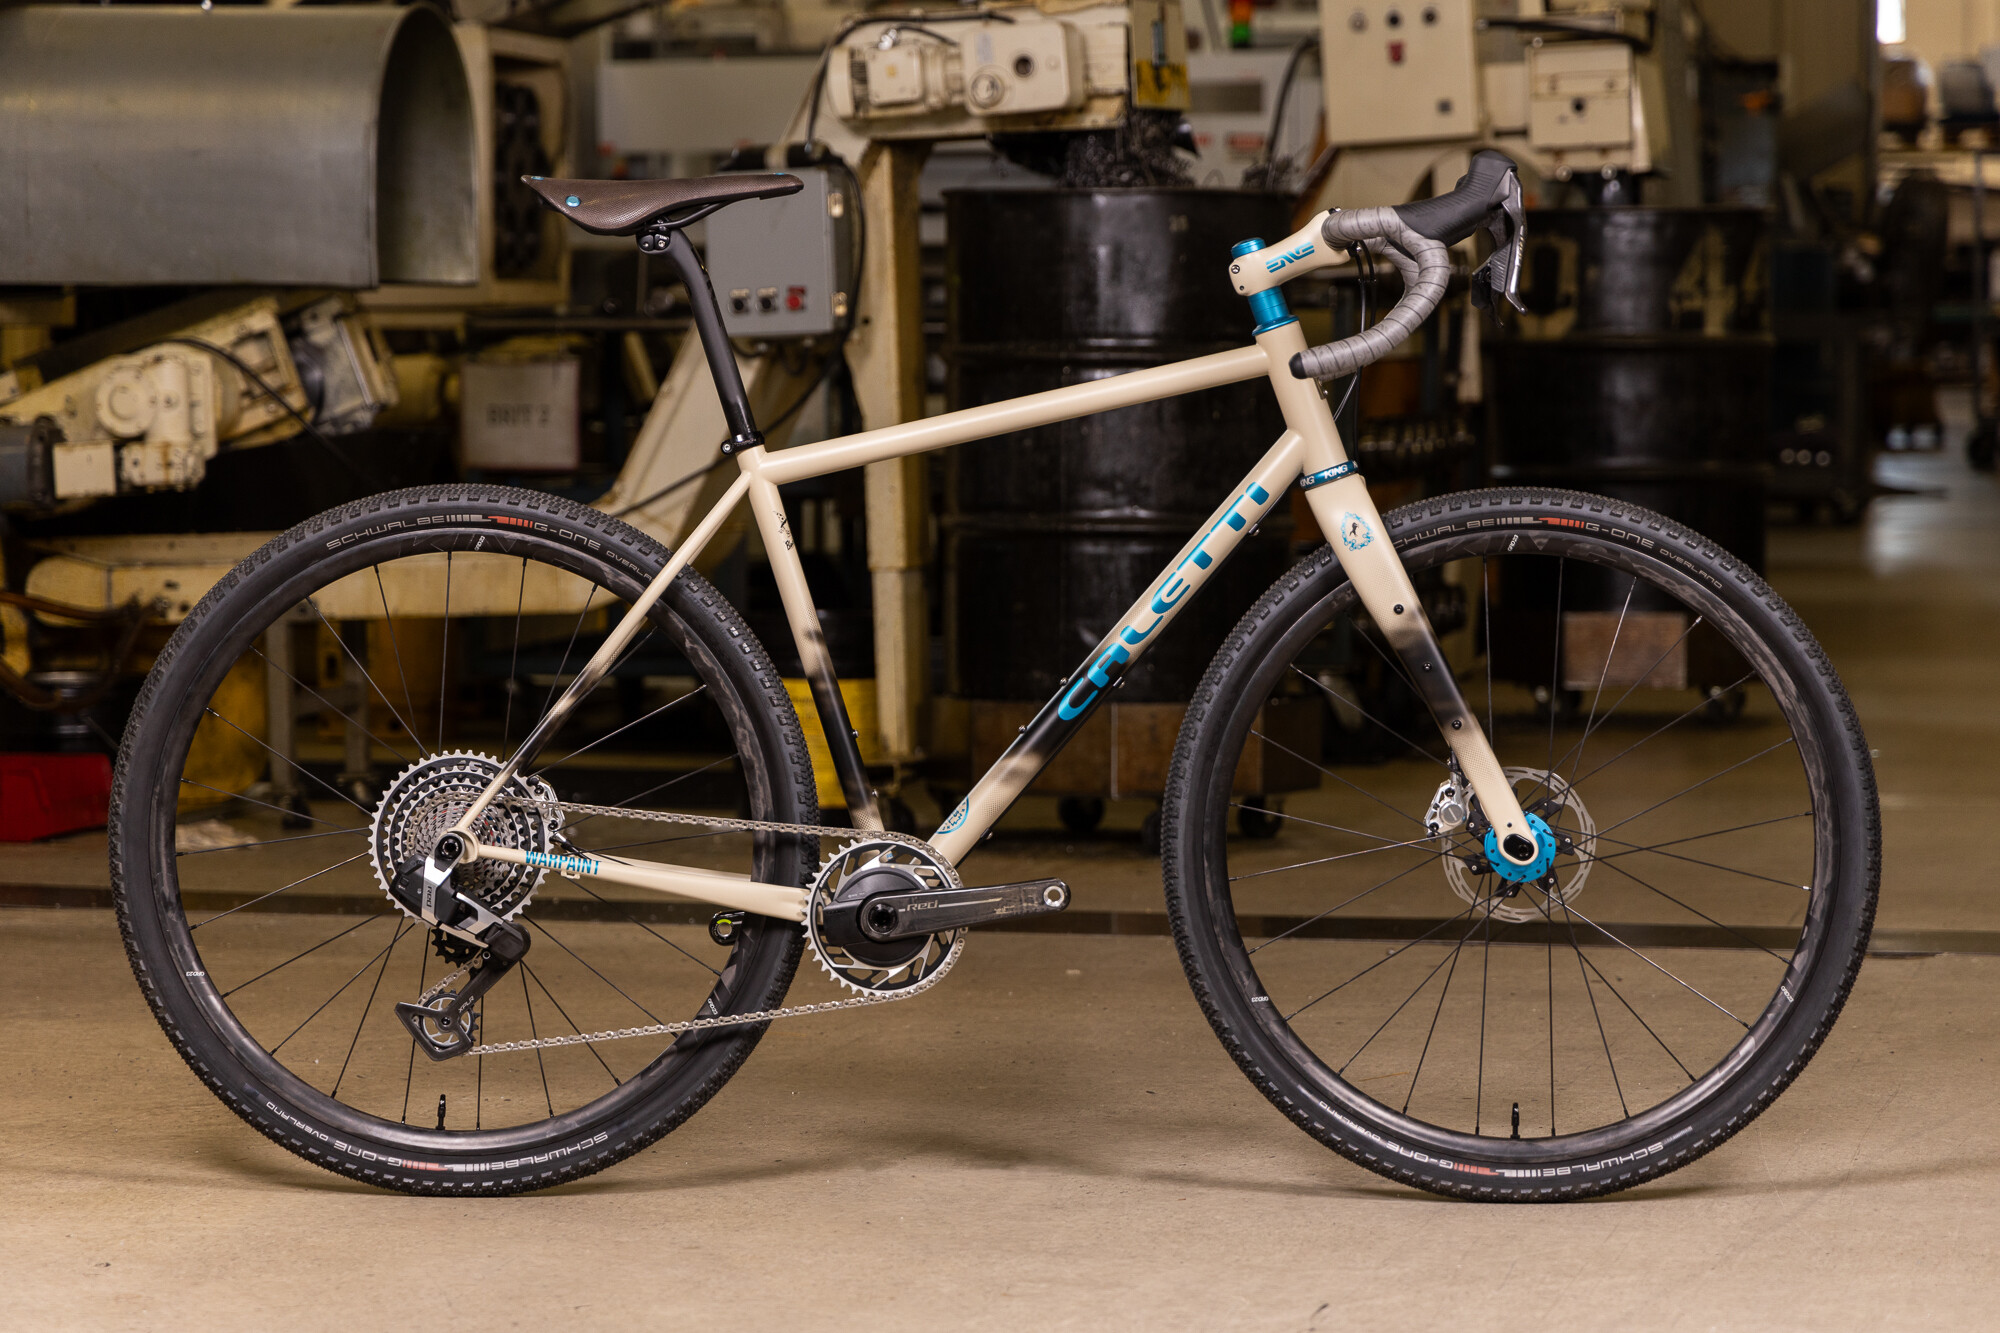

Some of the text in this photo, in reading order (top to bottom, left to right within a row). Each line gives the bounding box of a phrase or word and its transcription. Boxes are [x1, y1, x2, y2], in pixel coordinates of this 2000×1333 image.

[1265, 241, 1315, 273] ENVE
[1324, 464, 1348, 479] KING
[326, 514, 654, 582] SCHWALBE G-ONE OVERLA
[1393, 518, 1723, 589] CHWALBE G-ONE OVERLAND
[1057, 481, 1270, 721] CALETTI
[525, 850, 602, 875] WARPAINT
[266, 1101, 609, 1171] SCHWALBE G-ONE OVERLAND
[1319, 1100, 1664, 1177] SCHWALBE G-ONE OVERLAND
